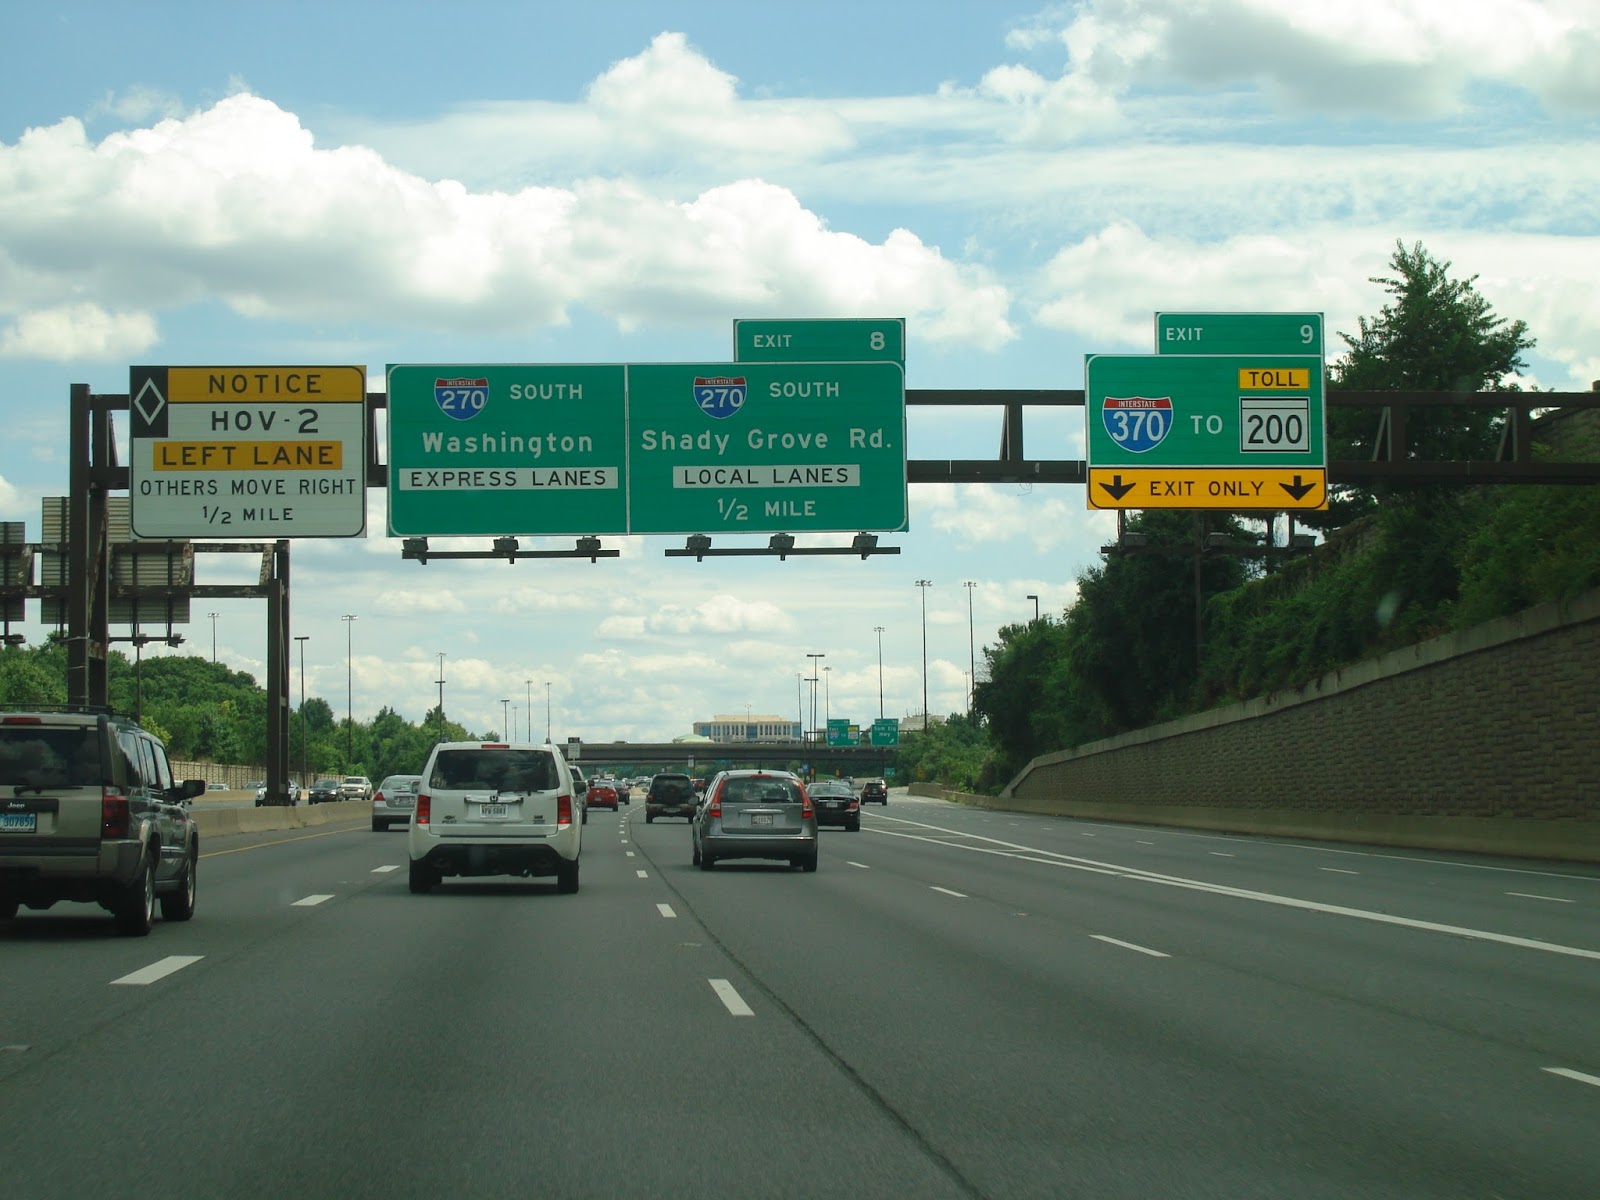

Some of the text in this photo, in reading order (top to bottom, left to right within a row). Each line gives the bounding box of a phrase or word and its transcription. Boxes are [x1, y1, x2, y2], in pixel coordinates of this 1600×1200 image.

[754, 332, 885, 350] EXIT 8
[1166, 324, 1314, 344] EXIT 9
[209, 374, 321, 393] NOTICE
[1249, 372, 1300, 386] TOLL
[442, 384, 583, 409] 270 SOUTH
[701, 382, 839, 408] 270 SOUTH
[211, 408, 319, 434] HOV-2
[1112, 411, 1302, 444] 370 TO 200
[422, 431, 592, 458] Washington
[641, 428, 892, 455] Shady Grove Rd.
[162, 446, 333, 466] LEFT LANE
[411, 470, 606, 487] EXPRESS LANES
[685, 468, 848, 484] LOCAL LANES
[140, 479, 356, 495] OTHERS MOVE RIGHT
[1151, 481, 1264, 496] EXIT ONLY
[243, 508, 293, 521] MILE
[765, 501, 816, 516] MILE
